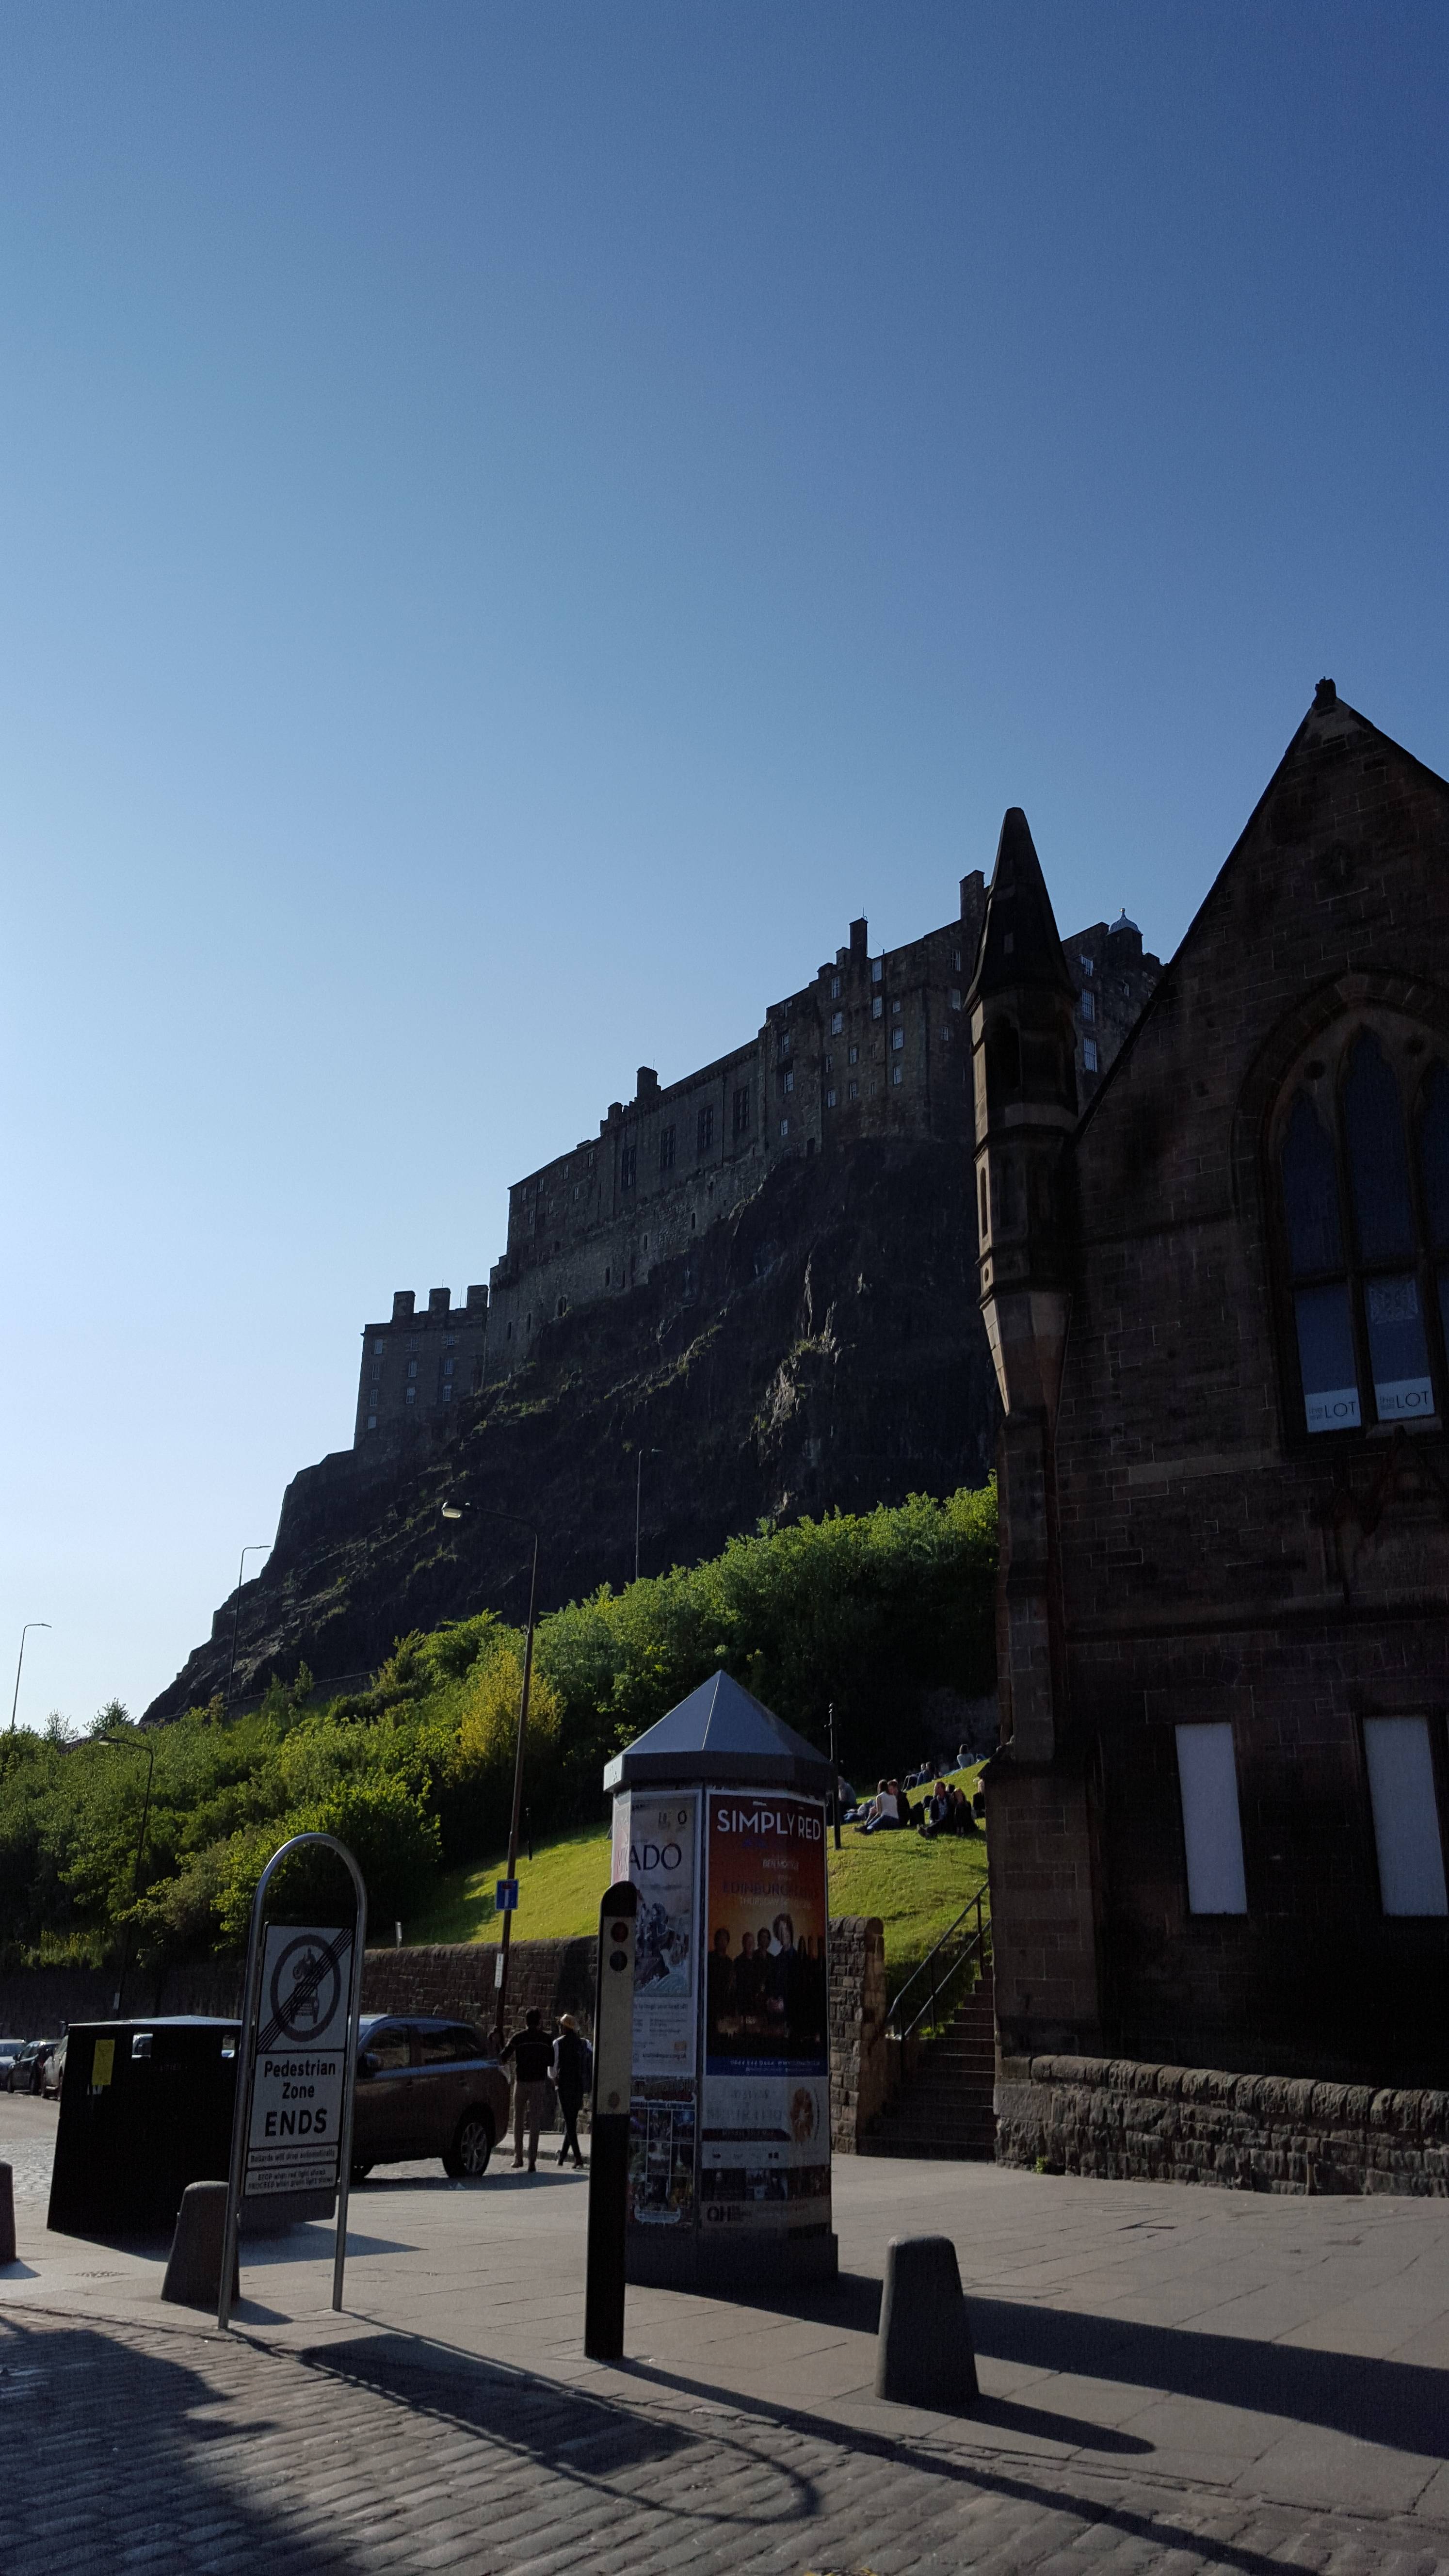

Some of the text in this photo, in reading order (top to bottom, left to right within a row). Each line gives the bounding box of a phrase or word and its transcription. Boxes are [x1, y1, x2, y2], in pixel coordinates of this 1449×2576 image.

[1397, 1391, 1429, 1408] LOT
[1324, 1401, 1356, 1419] LOT
[717, 1809, 821, 1840] SIMPLY RED
[264, 2059, 336, 2078] Pedestrian
[282, 2082, 315, 2099] Zone
[265, 2108, 327, 2137] ENDS
